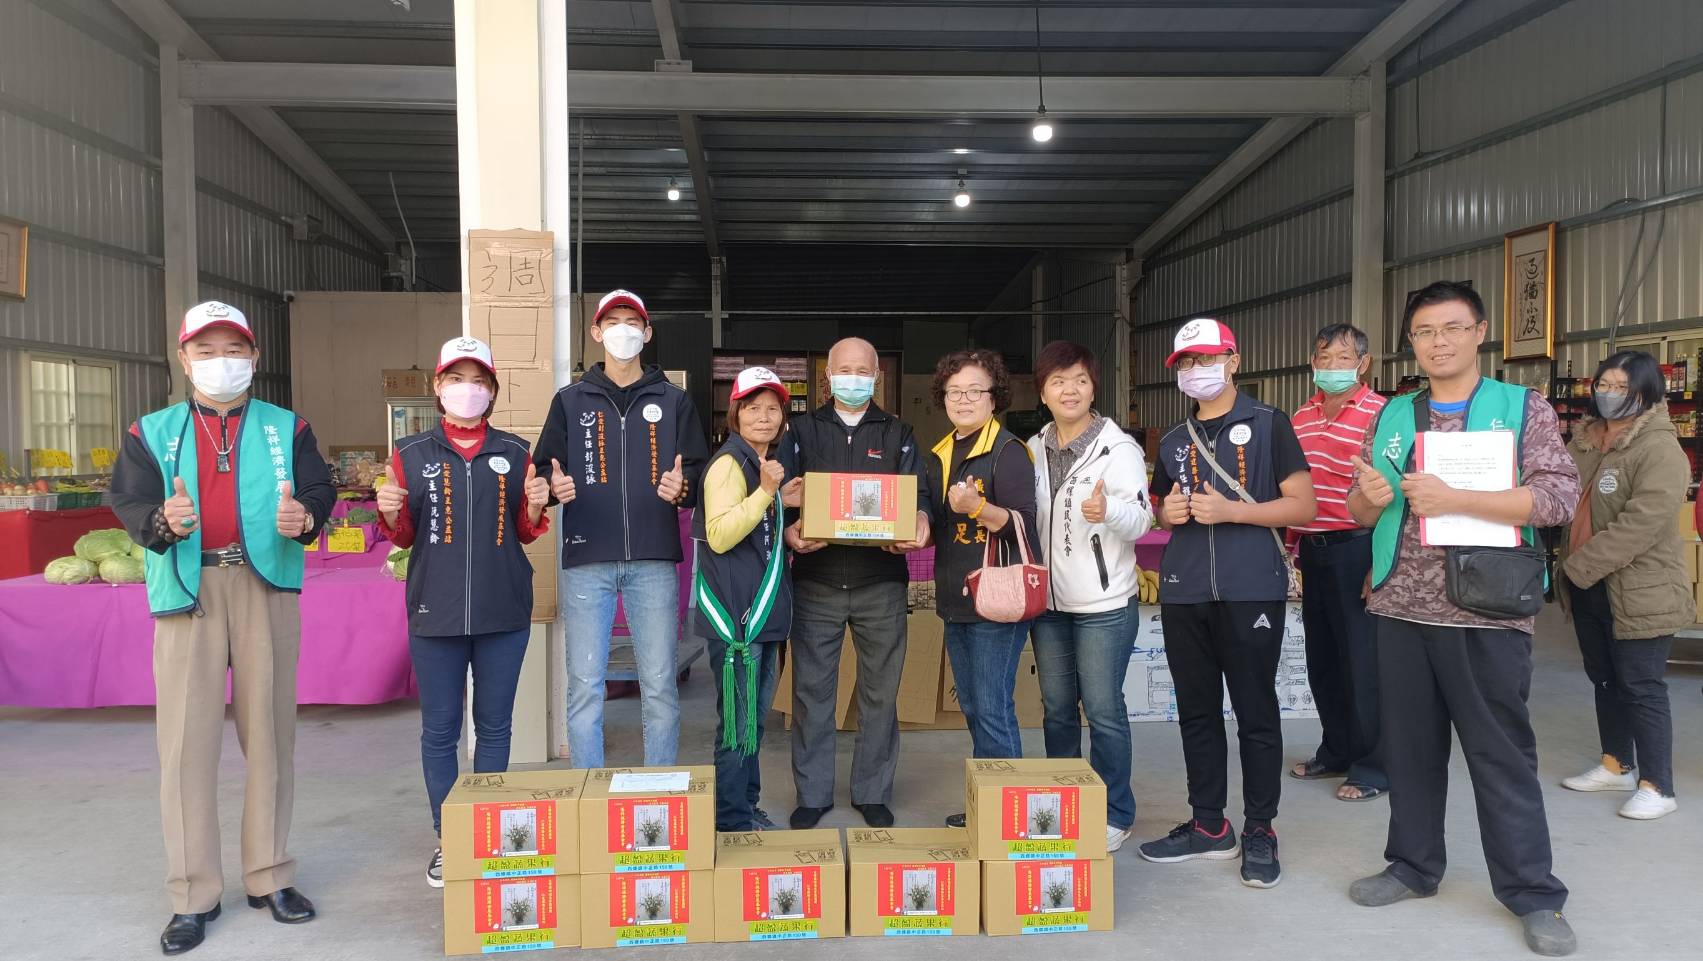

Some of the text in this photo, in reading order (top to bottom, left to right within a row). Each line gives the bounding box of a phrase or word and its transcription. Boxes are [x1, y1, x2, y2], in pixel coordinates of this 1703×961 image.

[264, 425, 287, 505] 隆祥經濟發展
[1382, 432, 1402, 459] 志
